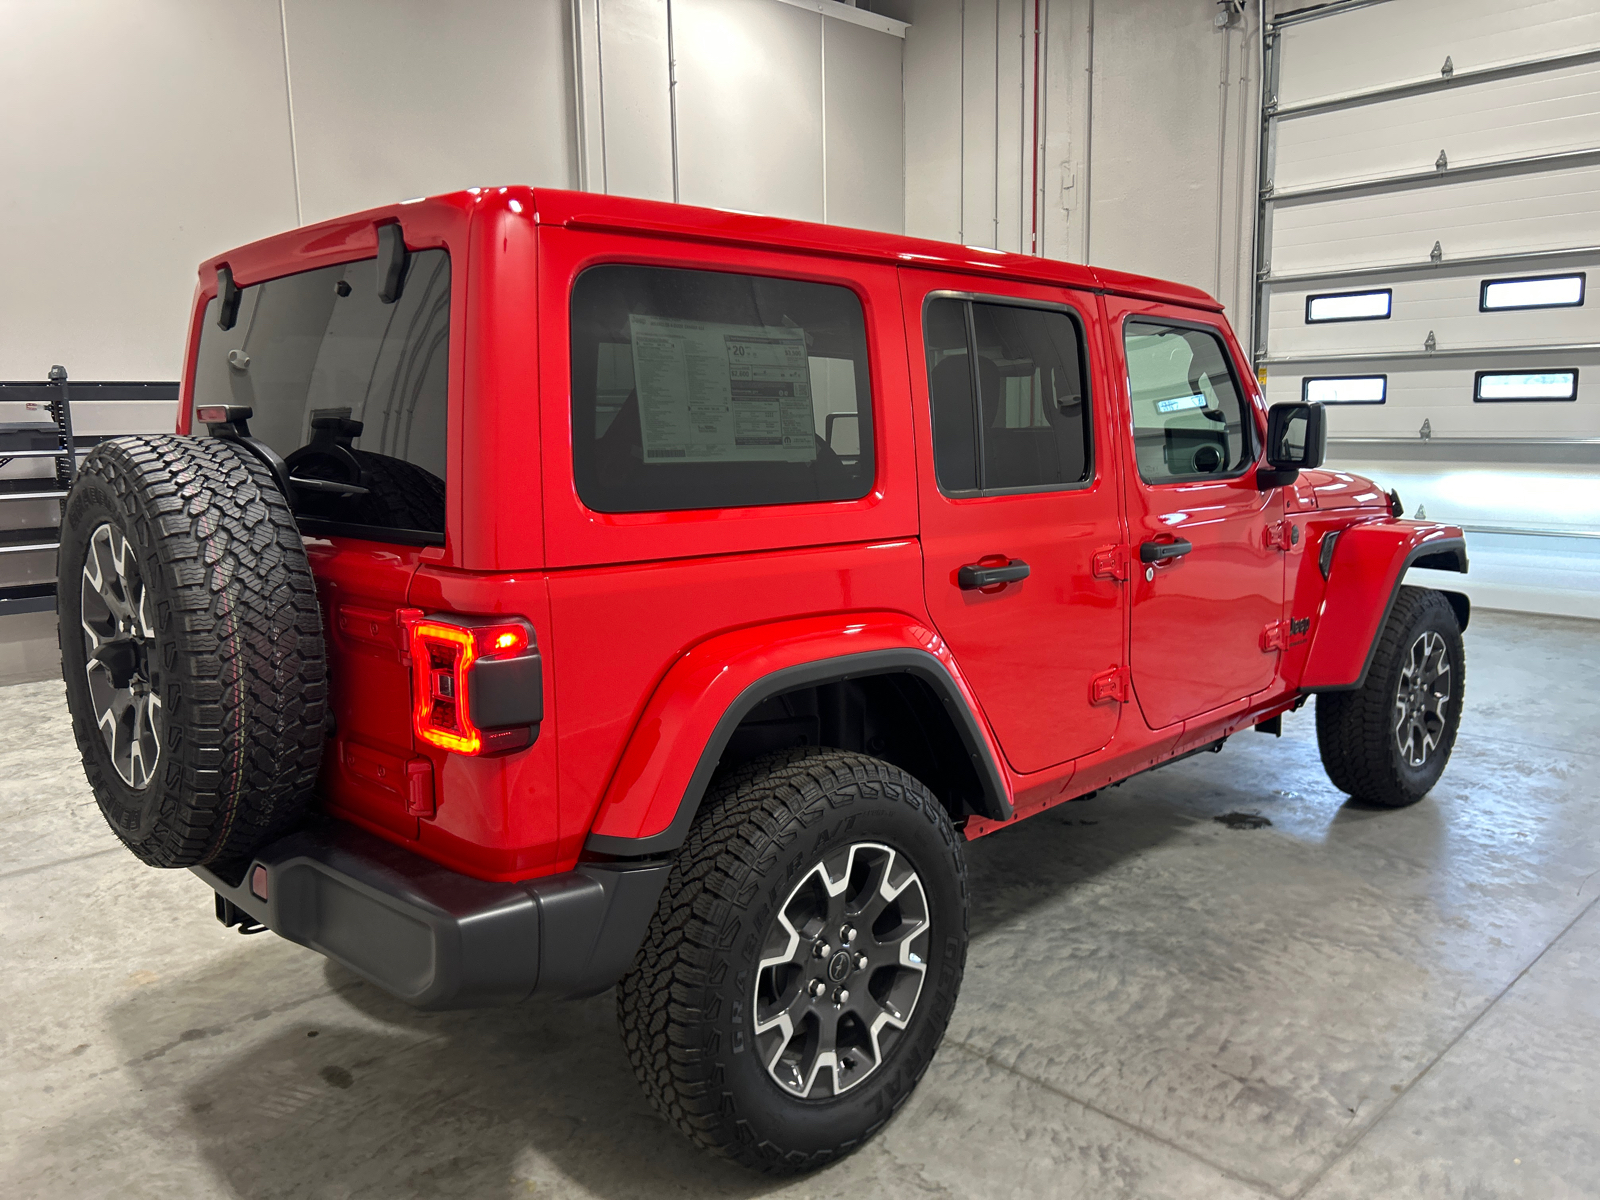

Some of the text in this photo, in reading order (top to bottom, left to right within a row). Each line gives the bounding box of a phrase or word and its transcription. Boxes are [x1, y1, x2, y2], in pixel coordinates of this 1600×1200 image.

[733, 345, 745, 356] 20
[1289, 616, 1309, 636] Jeep
[731, 850, 803, 1054] GRABBER
[864, 935, 960, 1115] GENERAL
